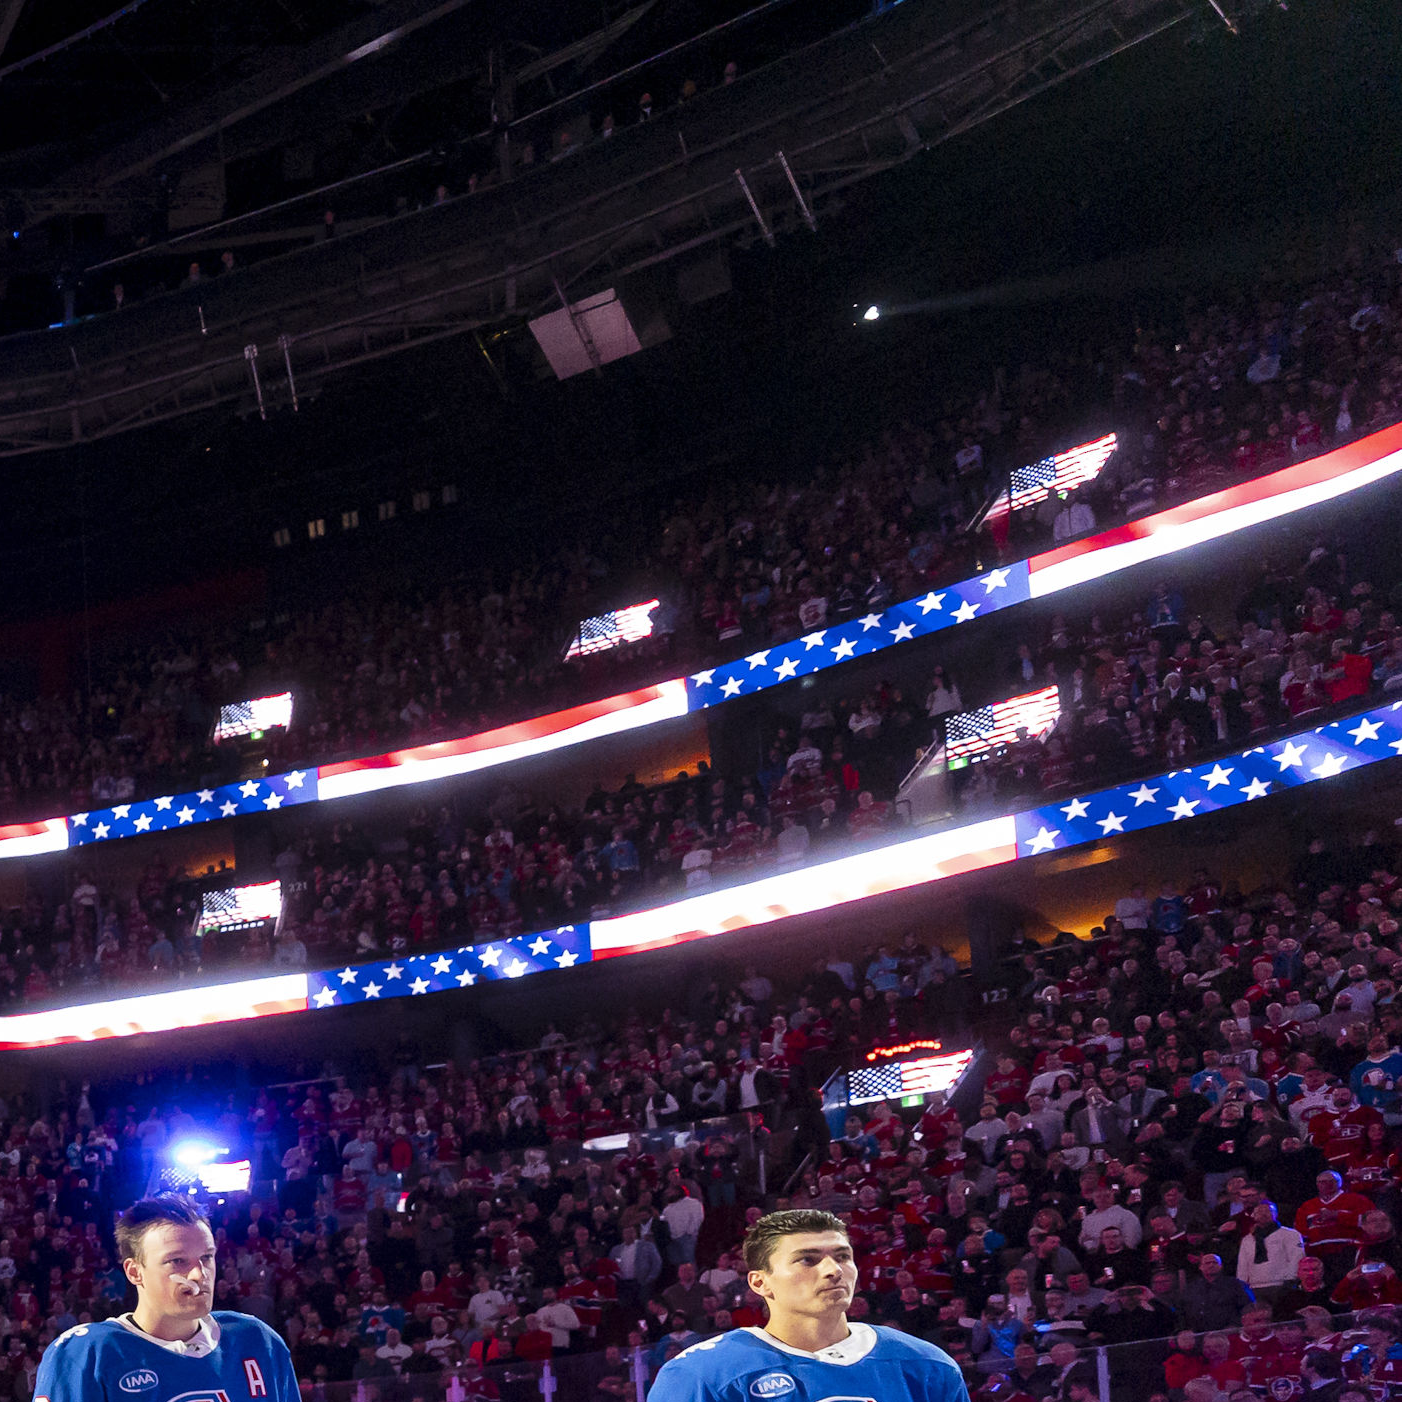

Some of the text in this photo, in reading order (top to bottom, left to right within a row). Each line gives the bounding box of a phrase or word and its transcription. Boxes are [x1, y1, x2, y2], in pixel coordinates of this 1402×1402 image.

[126, 1373, 155, 1388] IMA
[243, 1358, 267, 1398] A
[757, 1377, 791, 1393] IMA
